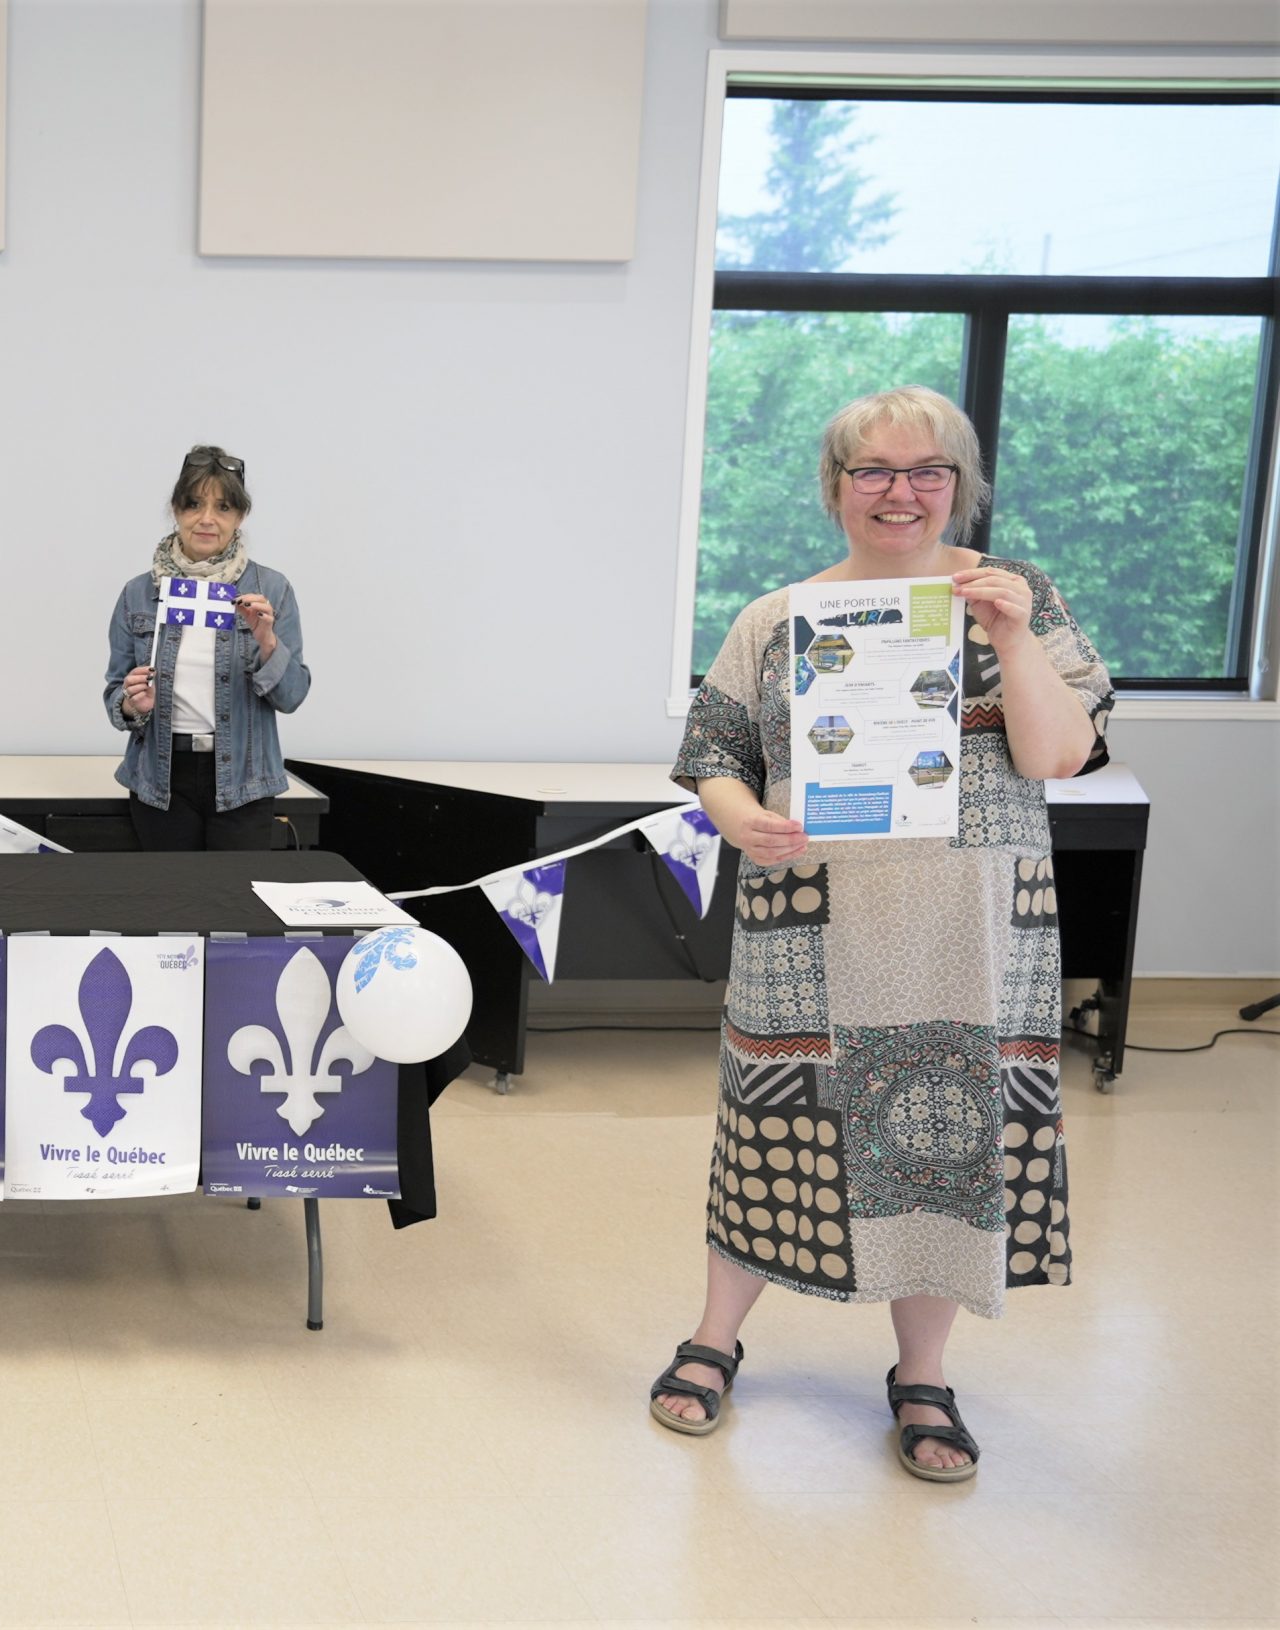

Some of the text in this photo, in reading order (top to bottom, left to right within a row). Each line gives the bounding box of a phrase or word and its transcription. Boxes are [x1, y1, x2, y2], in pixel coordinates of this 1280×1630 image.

[820, 597, 900, 609] UNE PORTE SUR
[160, 959, 187, 969] QUÉBEC
[40, 1144, 166, 1165] Vivre le Québec
[236, 1143, 364, 1163] Vivre le Québec
[66, 1167, 135, 1180] Tissé serré
[264, 1165, 335, 1178] Tissé serré
